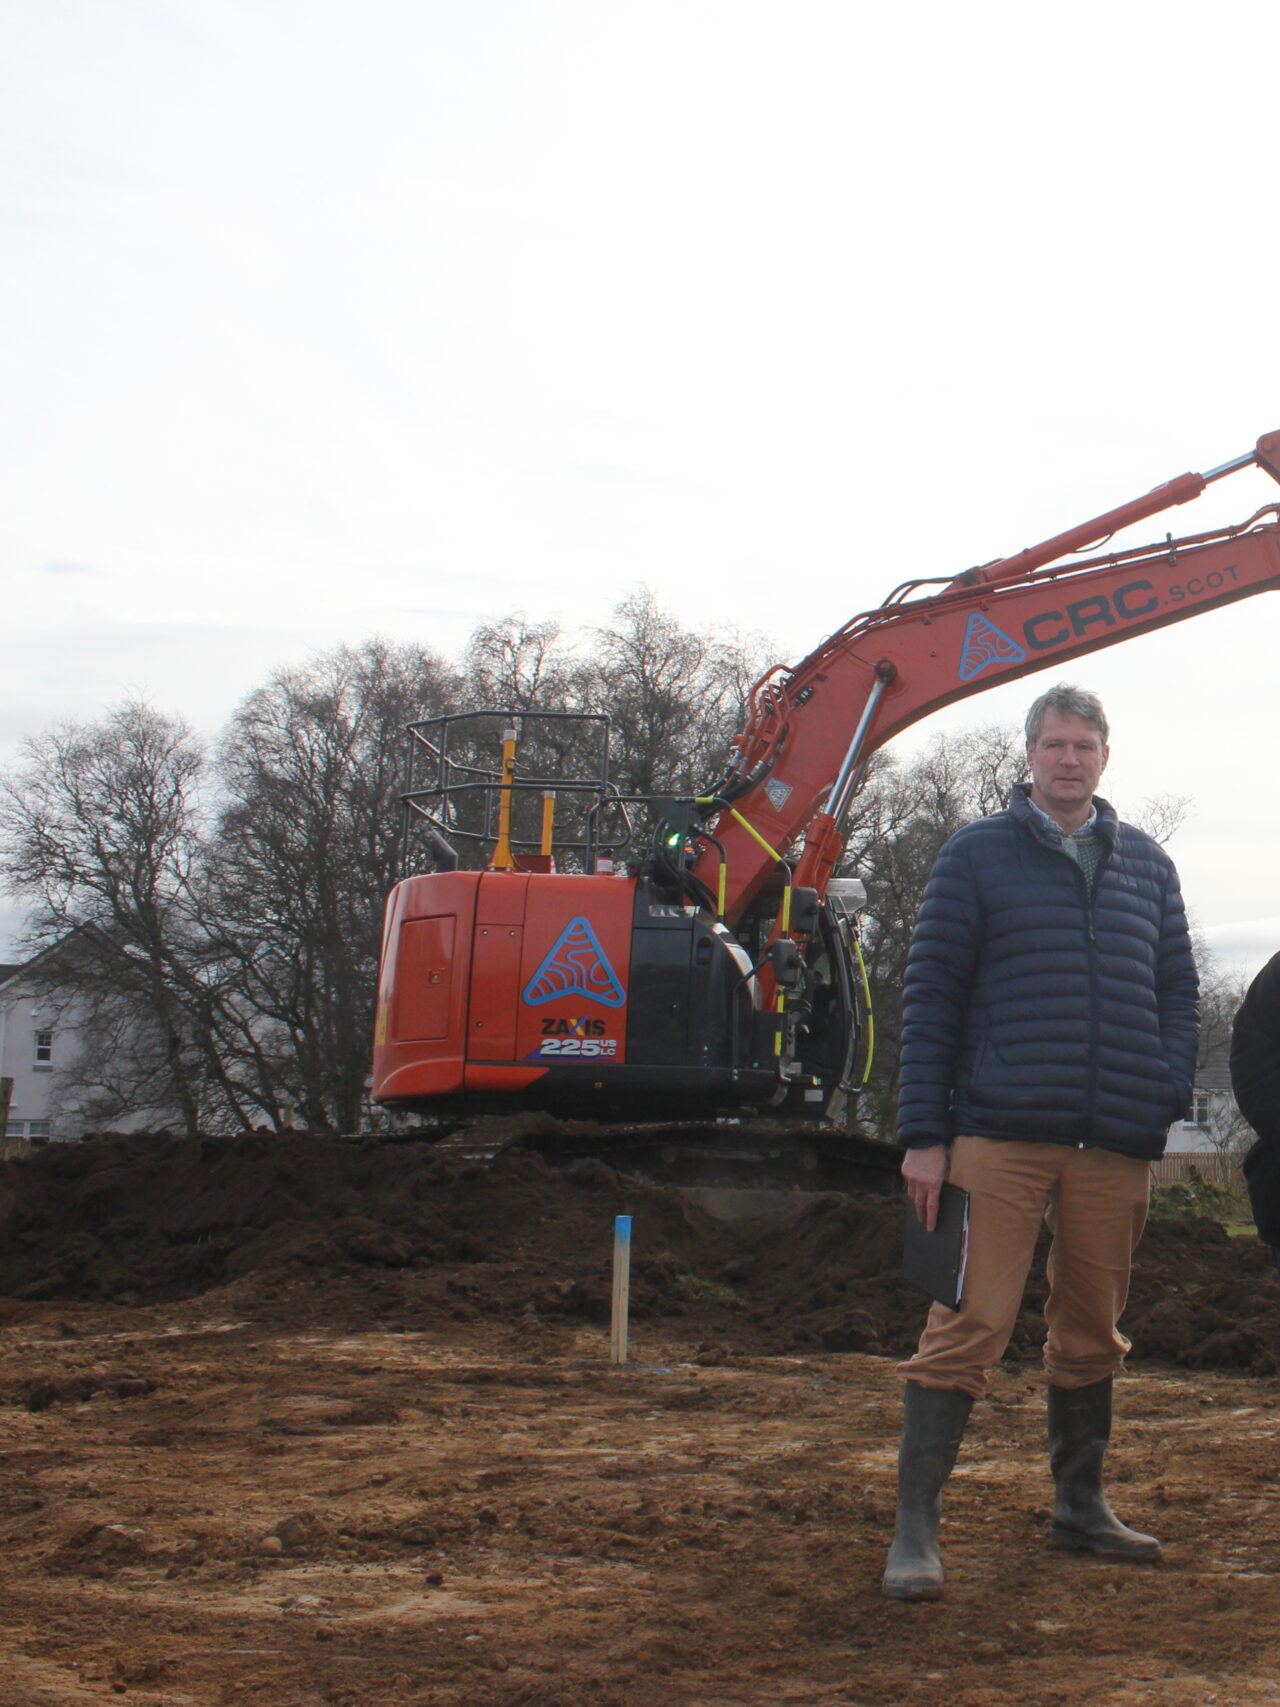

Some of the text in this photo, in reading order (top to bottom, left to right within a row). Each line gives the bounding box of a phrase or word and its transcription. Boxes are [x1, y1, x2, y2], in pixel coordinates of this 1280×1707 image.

[1022, 579, 1159, 650] CRC
[541, 1015, 607, 1036] ZAXIS
[540, 1038, 600, 1056] 225
